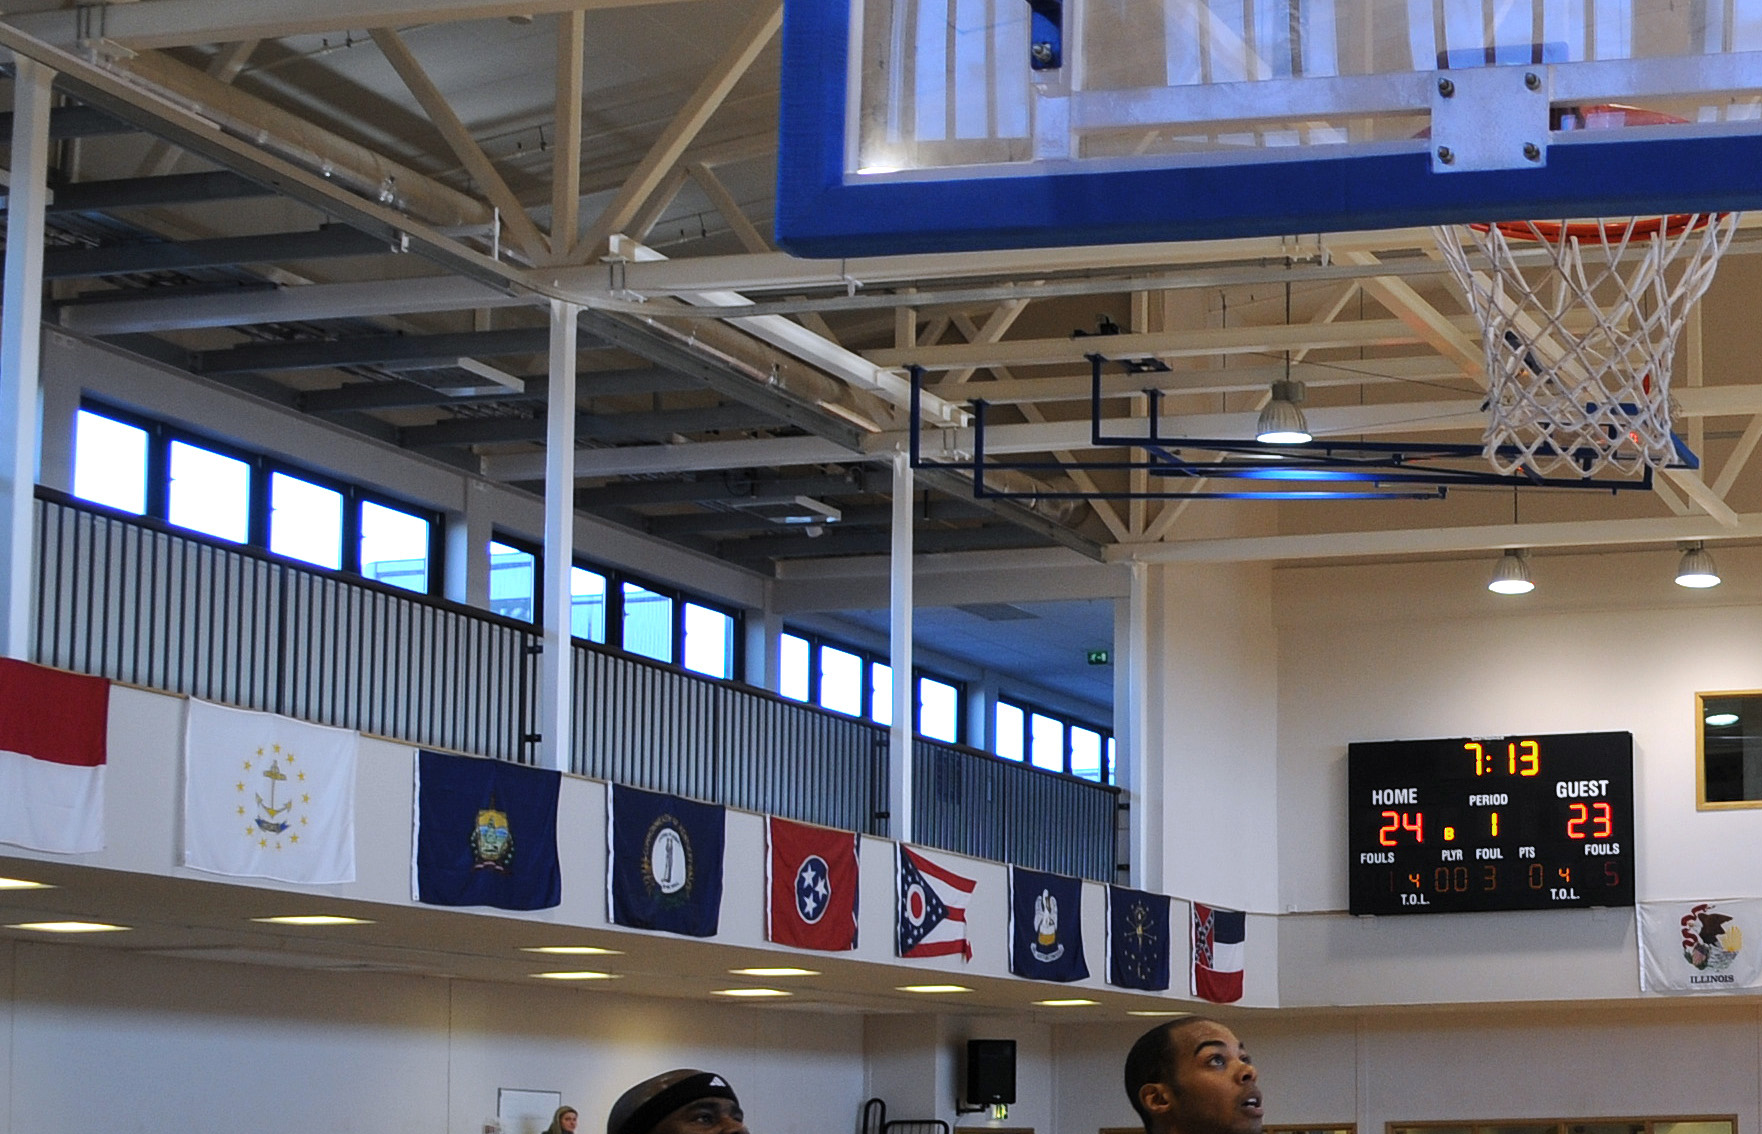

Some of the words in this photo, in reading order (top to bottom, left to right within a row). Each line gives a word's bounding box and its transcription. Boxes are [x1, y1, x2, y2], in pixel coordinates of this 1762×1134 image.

[1463, 741, 1540, 777] 7:13
[1372, 788, 1418, 805] HOME
[1556, 780, 1609, 798] GUEST
[1468, 794, 1508, 806] PERIOD
[1490, 811, 1499, 837] 1
[1567, 802, 1613, 839] 23
[1379, 810, 1423, 847] 24
[1441, 849, 1463, 861] PLYR
[1475, 847, 1503, 860] FOUL
[1518, 846, 1536, 859] PTS
[1584, 843, 1620, 856] FOULS
[1360, 852, 1395, 864] FOULS
[1408, 873, 1420, 888] 4
[1558, 867, 1570, 883] 4
[1690, 974, 1735, 984] ILLINOIS
